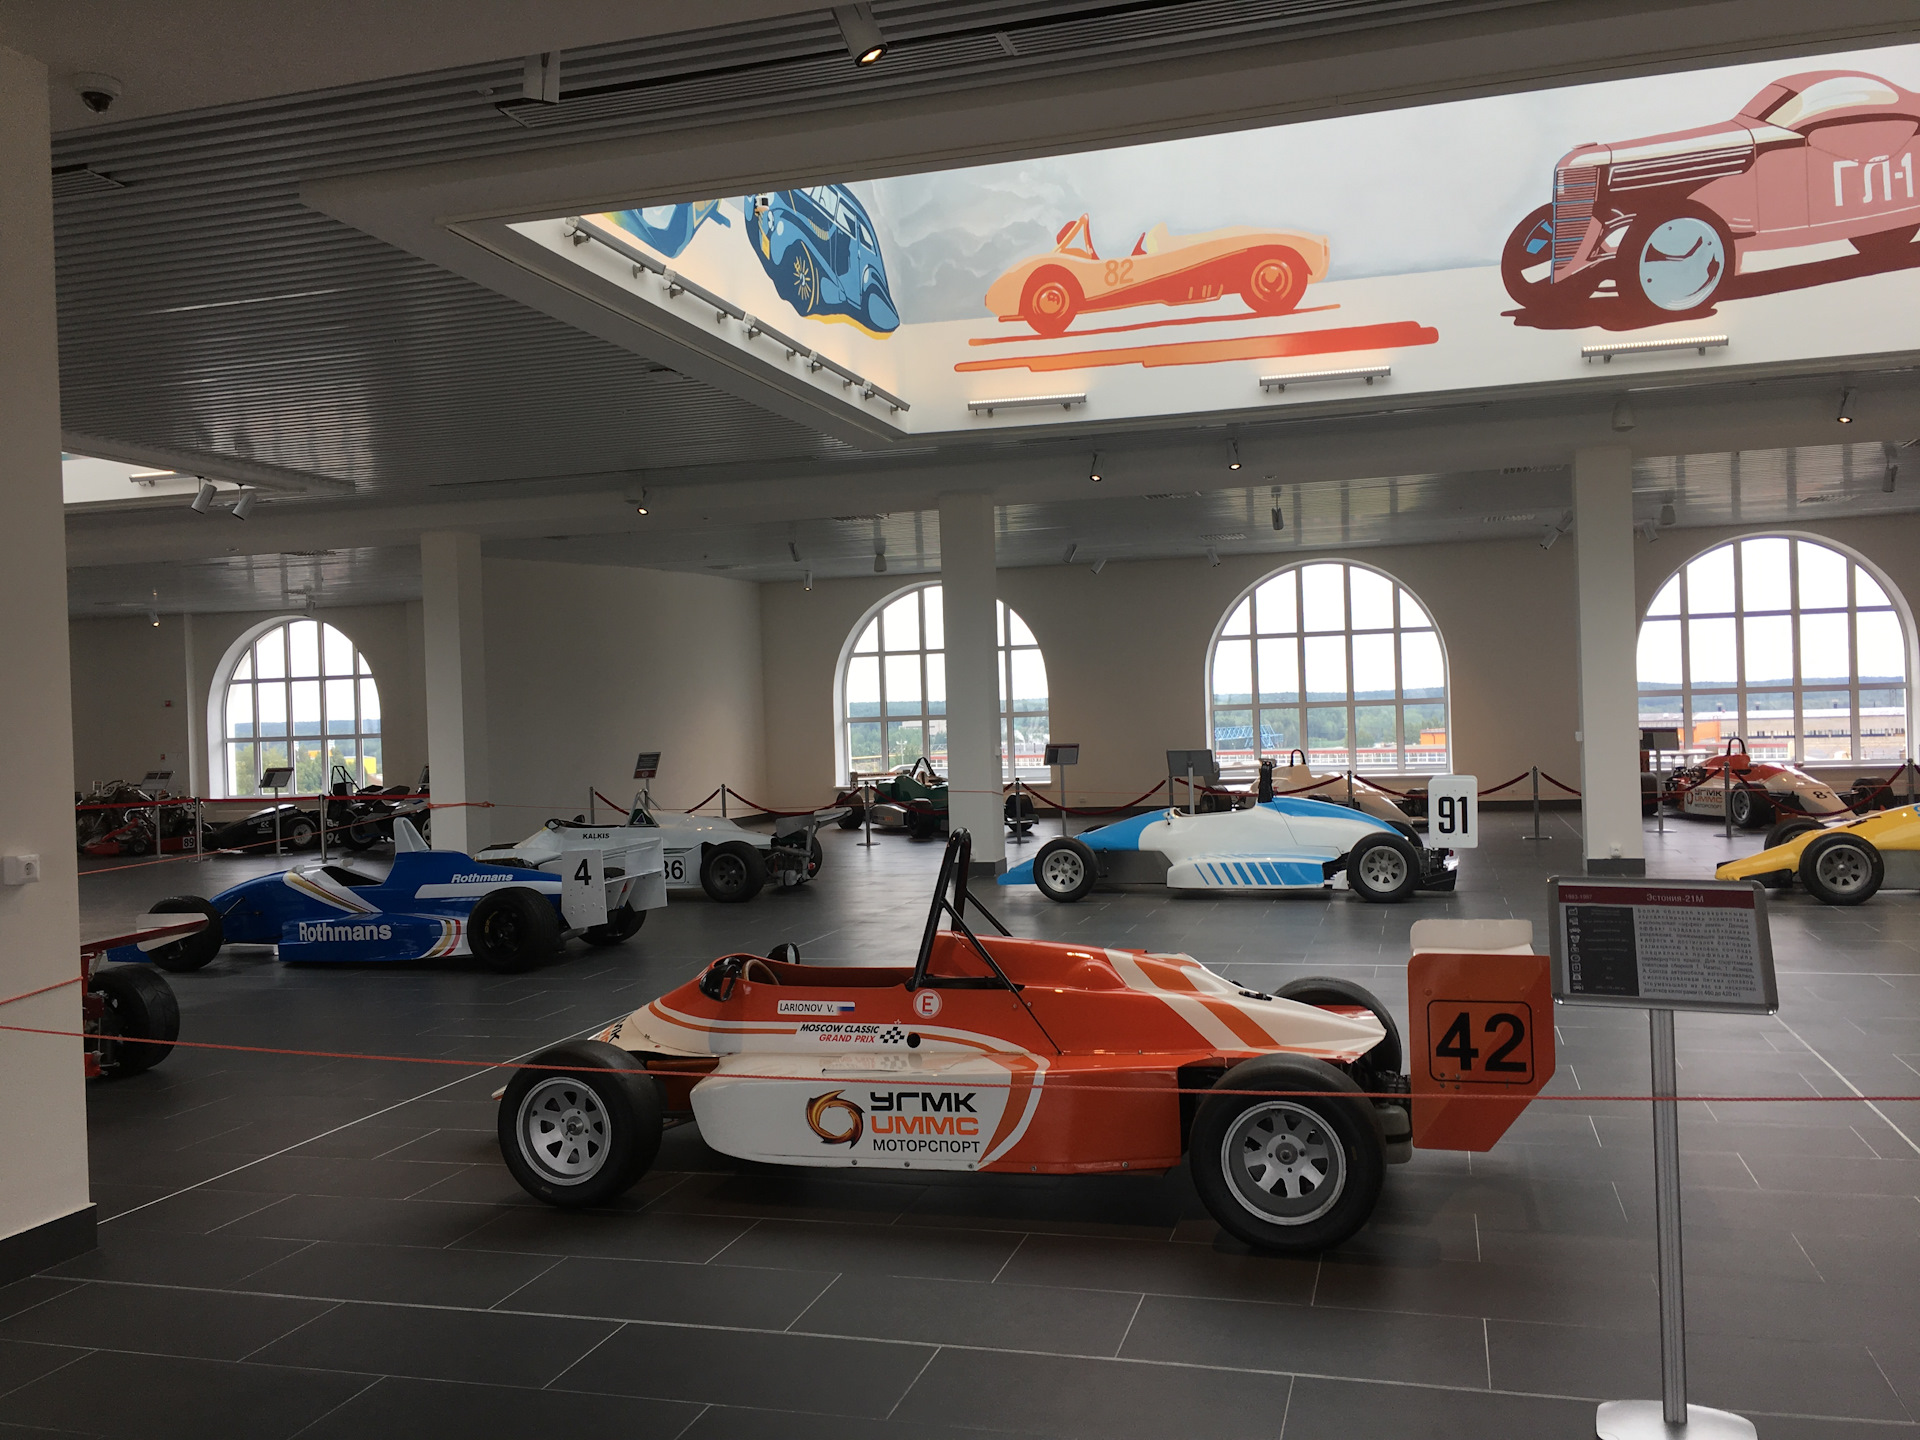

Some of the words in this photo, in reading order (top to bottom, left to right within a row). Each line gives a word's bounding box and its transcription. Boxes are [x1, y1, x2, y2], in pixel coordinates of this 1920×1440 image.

[1833, 152, 1914, 207] ГЛ-1
[1104, 258, 1135, 287] 82
[1438, 796, 1468, 834] 91
[183, 837, 195, 848] 89
[451, 872, 514, 884] Rothmans
[574, 858, 592, 886] 4
[1646, 892, 1704, 903] Эстония-21М
[298, 921, 392, 942] Rothmans
[780, 1003, 823, 1012] LARIONOV
[826, 1004, 834, 1013] V.
[921, 995, 934, 1014] E
[800, 1023, 843, 1033] MOSCOW
[844, 1025, 880, 1034] CLASSIC
[819, 1033, 852, 1042] GRAND
[854, 1034, 876, 1043] PRIX
[1435, 1011, 1527, 1073] 42
[869, 1091, 978, 1113] УГМК
[871, 1115, 980, 1136] UMMC
[872, 1138, 981, 1154] МОТОРСПОРТ
